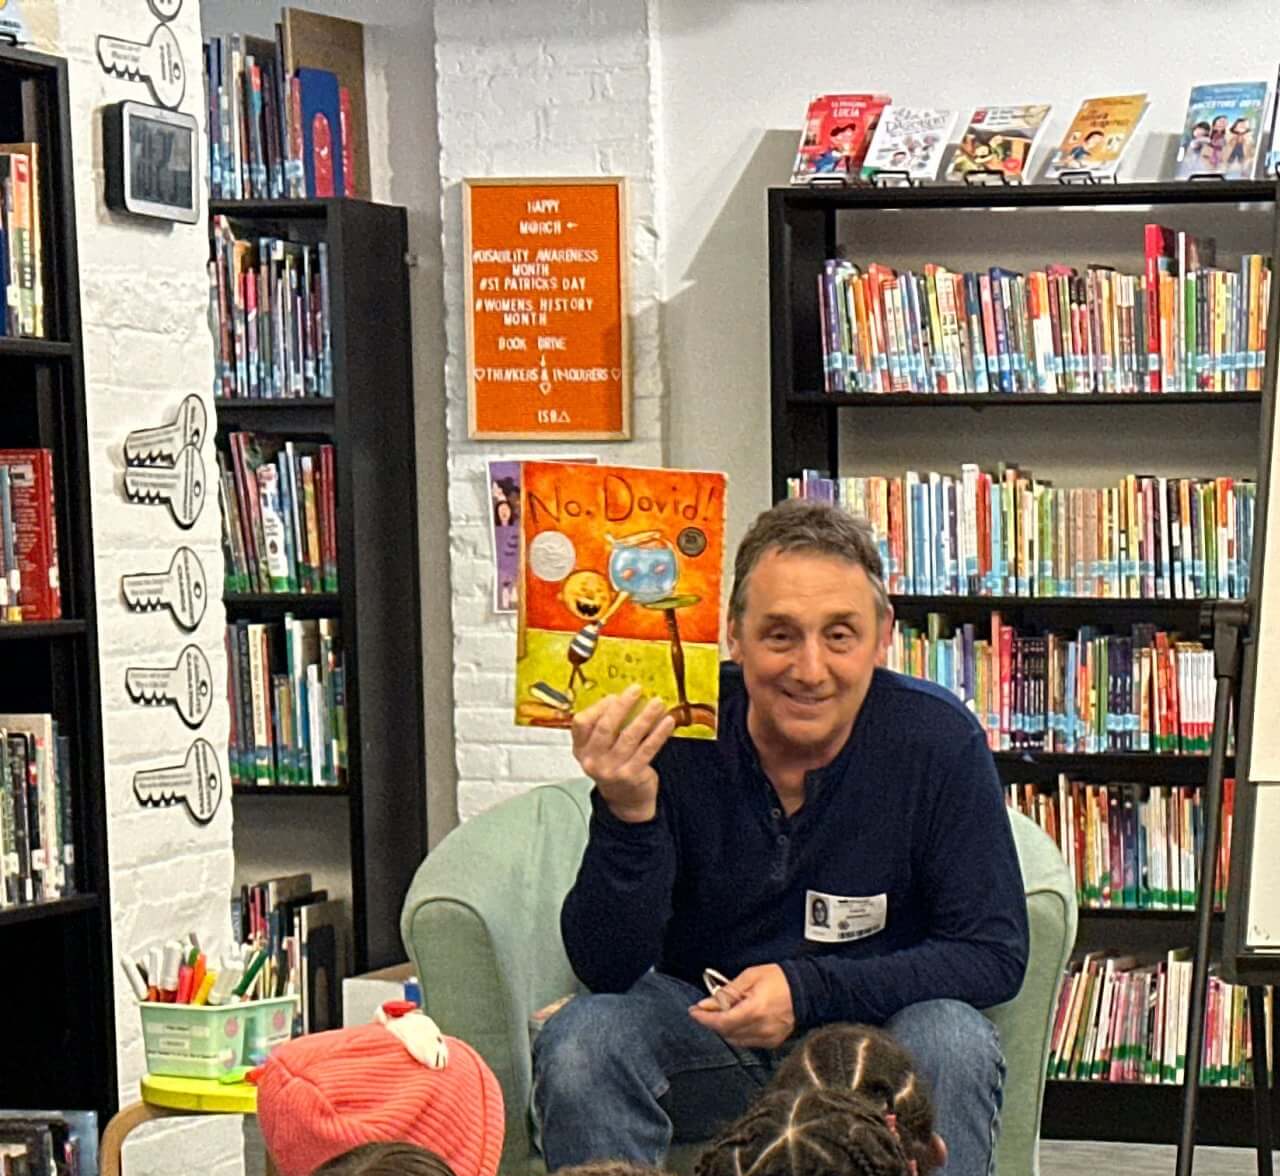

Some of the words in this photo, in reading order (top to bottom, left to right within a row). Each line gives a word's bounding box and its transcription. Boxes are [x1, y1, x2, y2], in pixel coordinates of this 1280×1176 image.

[527, 200, 560, 213] HAPPY
[536, 249, 599, 262] AWARENESS
[512, 264, 549, 276] MONTH
[504, 278, 557, 290] PATRICKS
[562, 277, 586, 290] DAY
[540, 298, 593, 311] HISTORY
[504, 312, 547, 326] MONTH
[603, 473, 716, 522] David!
